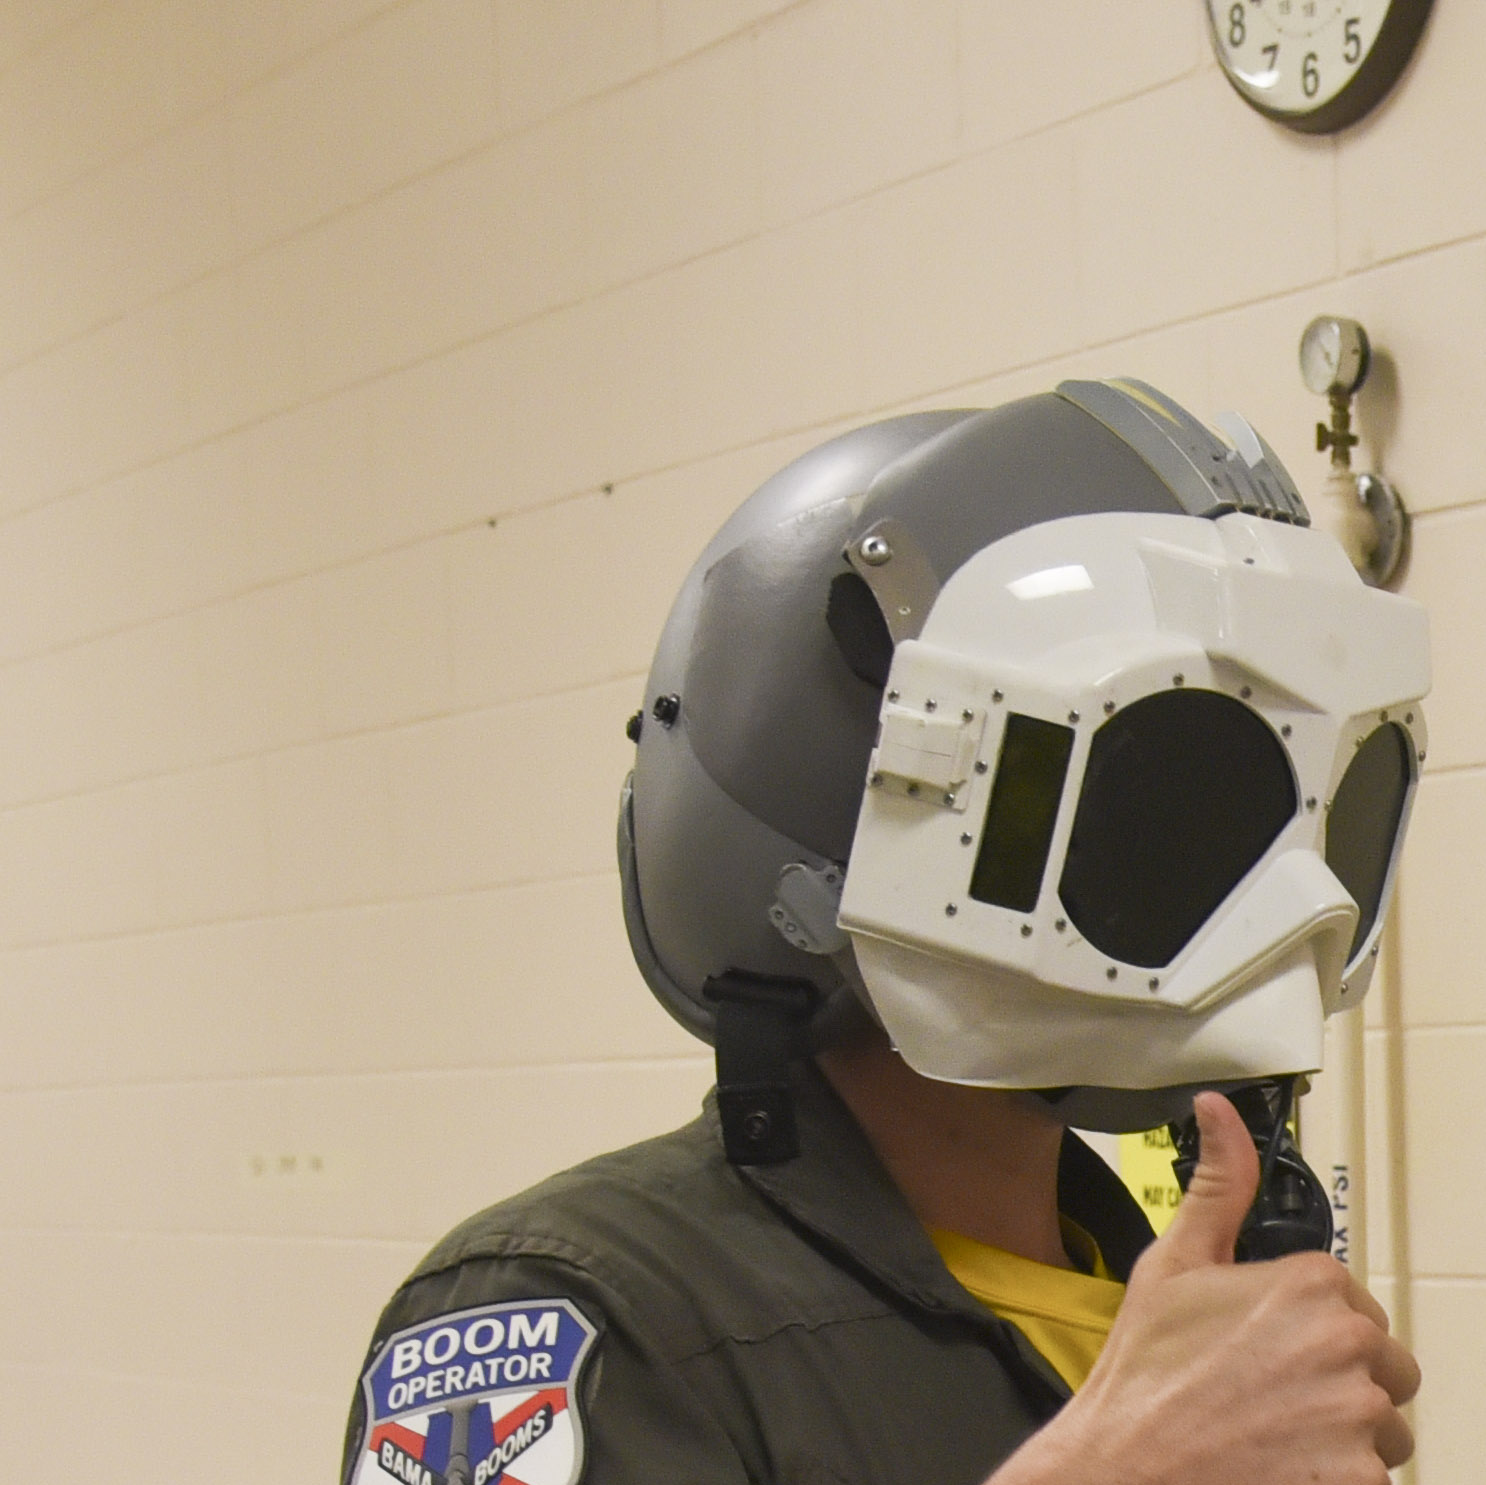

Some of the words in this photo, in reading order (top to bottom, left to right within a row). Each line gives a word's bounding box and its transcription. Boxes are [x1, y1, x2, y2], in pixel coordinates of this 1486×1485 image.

[1229, 3, 1246, 48] 8
[1343, 17, 1361, 64] 5
[1262, 43, 1279, 72] 7
[1302, 52, 1320, 98] 6
[391, 1311, 560, 1380] BOOM
[387, 1352, 553, 1411] OPERATOR
